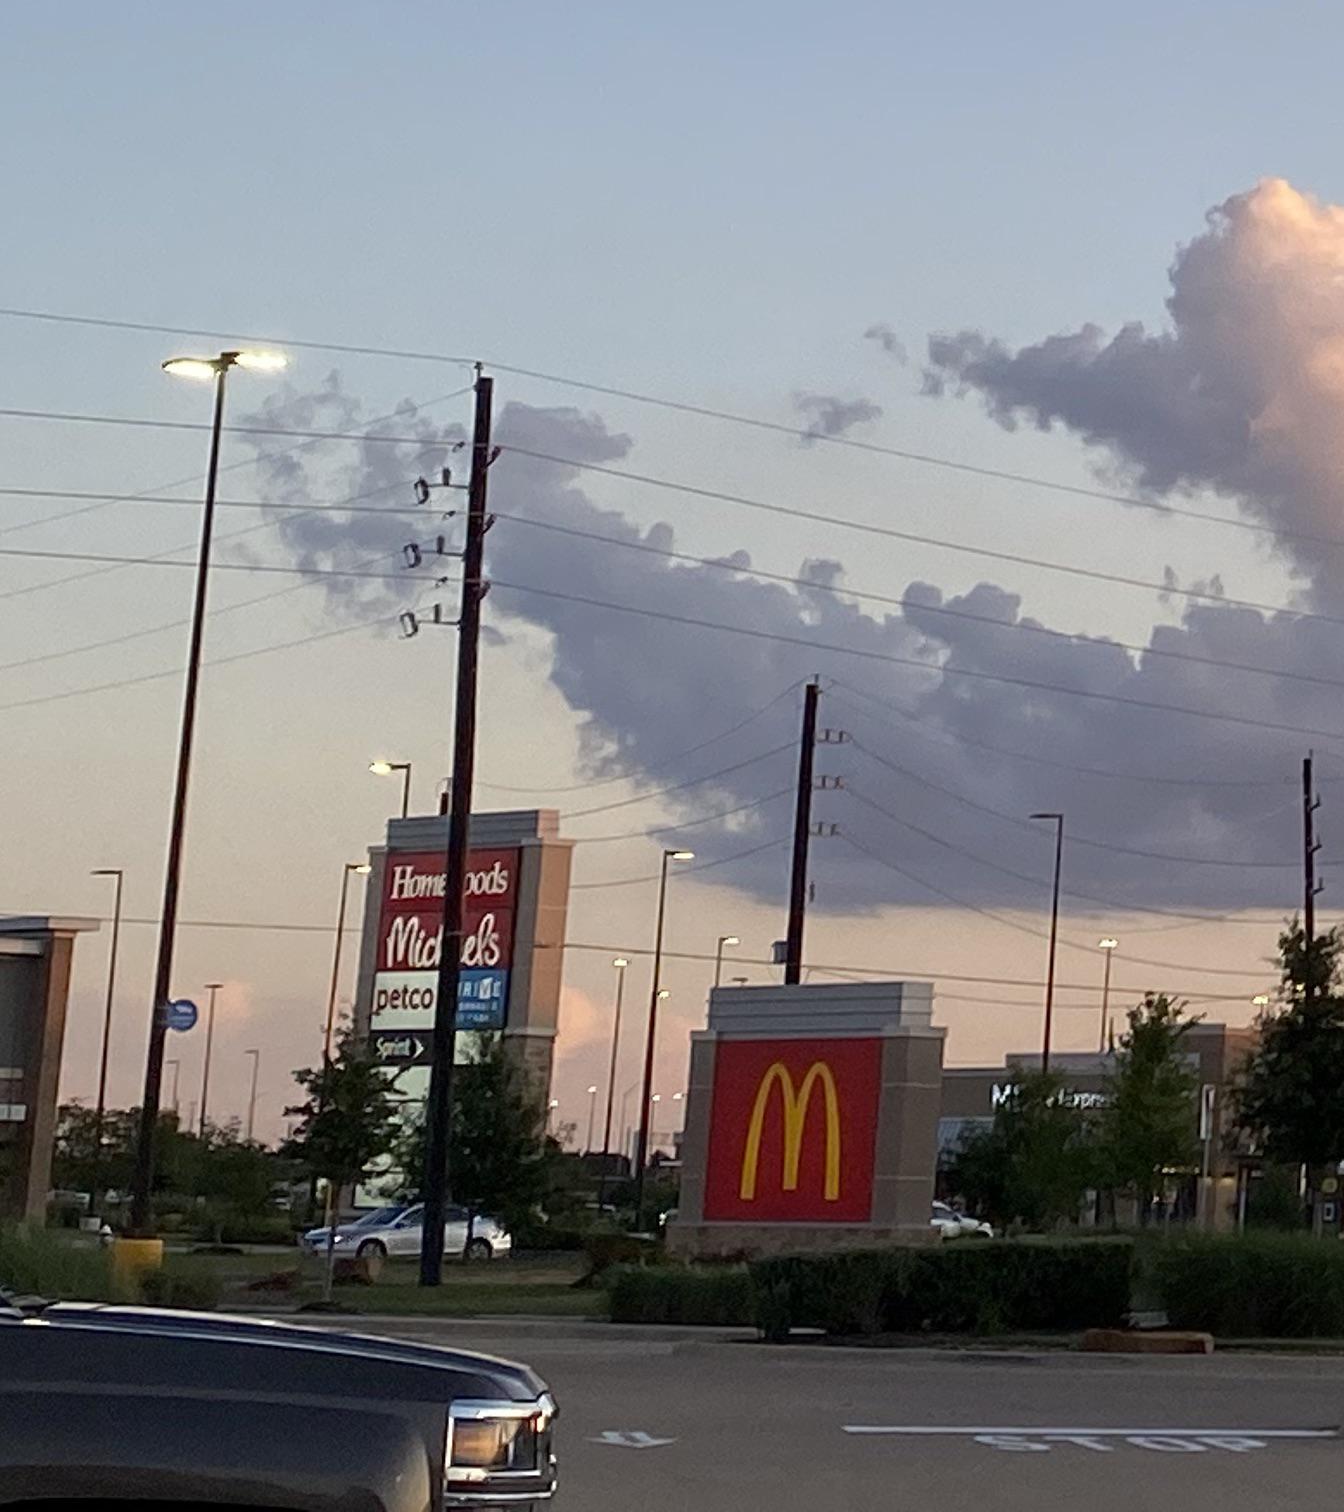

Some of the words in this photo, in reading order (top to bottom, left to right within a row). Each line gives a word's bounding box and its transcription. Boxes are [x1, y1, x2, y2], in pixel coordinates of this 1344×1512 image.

[391, 861, 508, 899] Homeoods
[386, 913, 499, 969] Micels
[377, 984, 433, 1009] petco
